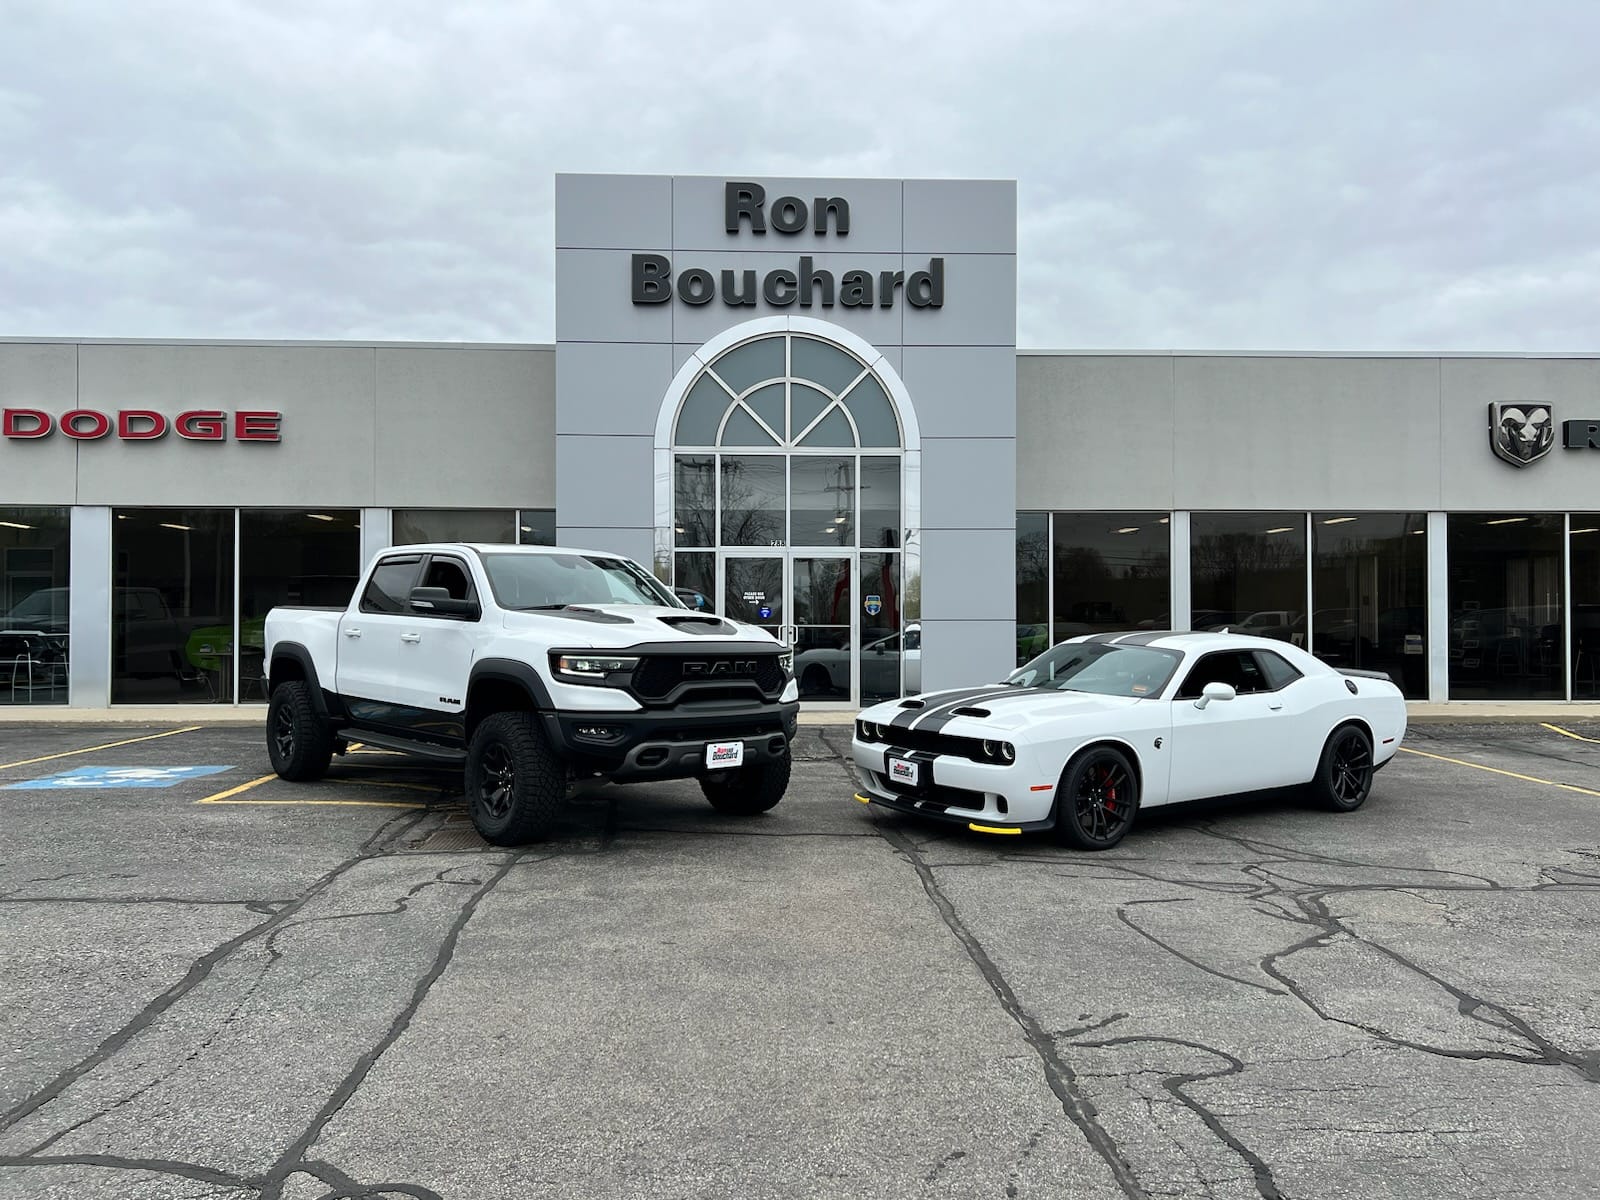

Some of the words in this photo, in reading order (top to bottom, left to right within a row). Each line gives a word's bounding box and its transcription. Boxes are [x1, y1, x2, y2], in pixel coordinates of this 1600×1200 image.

[725, 182, 850, 236] Ron
[631, 253, 945, 308] Bouchard
[3, 408, 281, 442] DODGE
[683, 660, 757, 674] RAM
[440, 696, 461, 705] RAM
